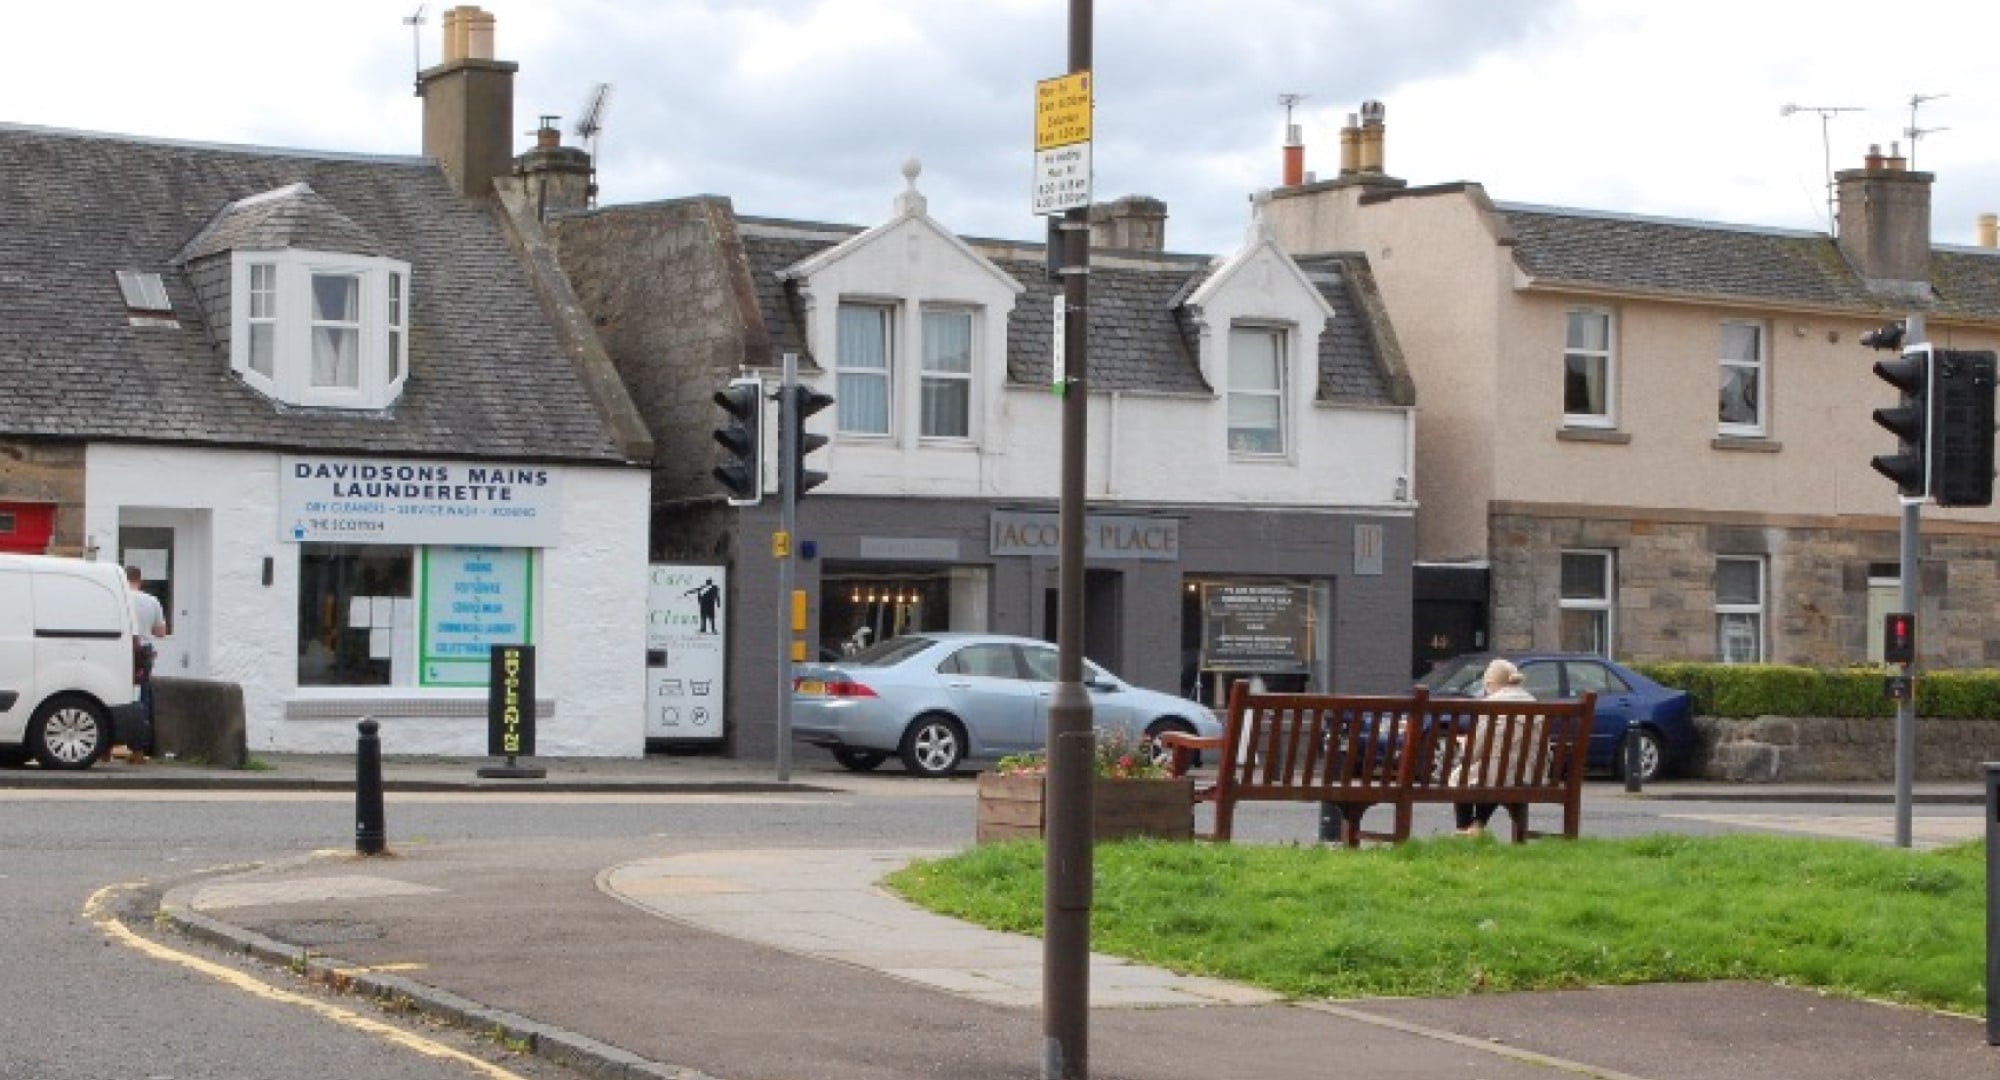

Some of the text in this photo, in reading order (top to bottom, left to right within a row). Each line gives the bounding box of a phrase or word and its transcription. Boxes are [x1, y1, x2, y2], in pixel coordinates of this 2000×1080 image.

[294, 463, 548, 486] DAVIDSONS MAINS
[333, 482, 511, 501] LAUNDERETTE
[306, 501, 328, 511] DRY
[1101, 524, 1176, 552] PLACE
[650, 609, 699, 626] Clean
